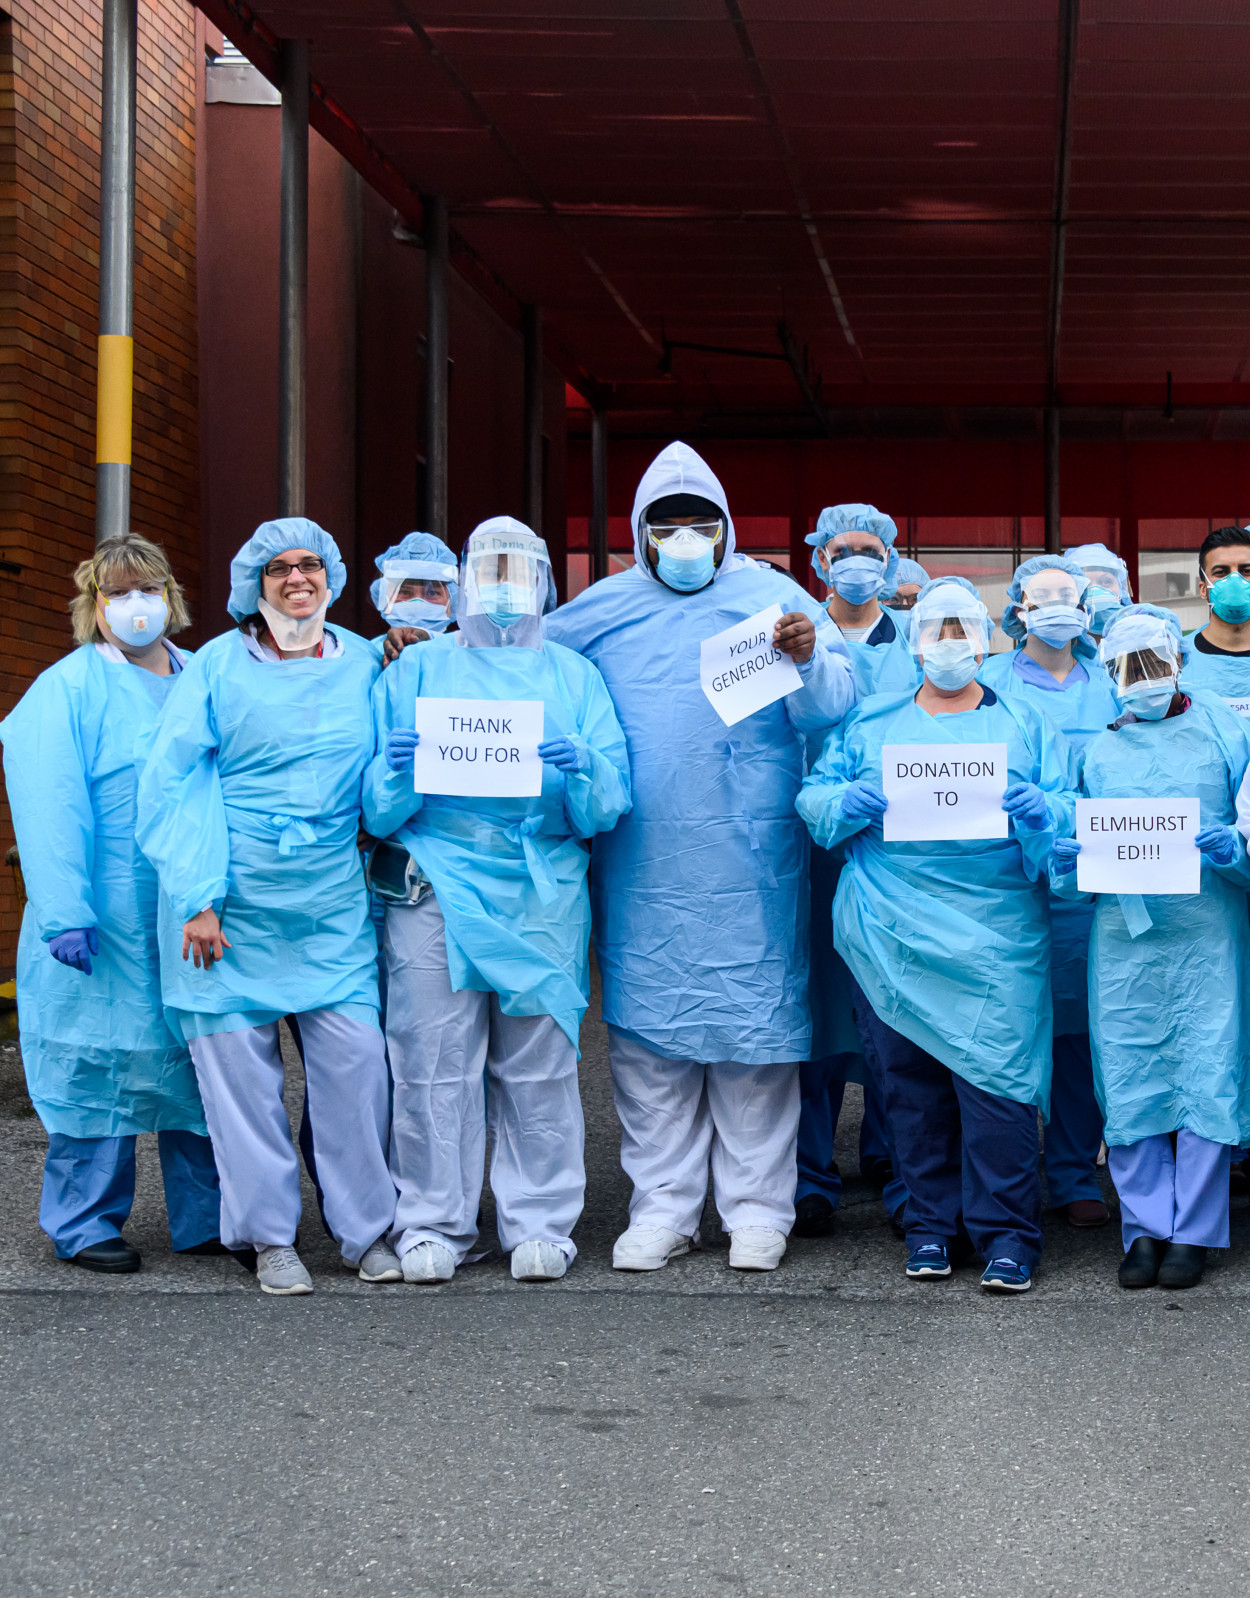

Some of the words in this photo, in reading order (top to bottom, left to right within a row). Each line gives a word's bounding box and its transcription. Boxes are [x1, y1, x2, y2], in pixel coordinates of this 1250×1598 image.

[729, 631, 767, 658] YOUR
[711, 648, 782, 693] GENEROUS
[448, 716, 512, 733] THANK
[438, 745, 478, 762] YOU
[485, 747, 520, 763] FOR
[897, 761, 994, 778] DONATION
[933, 791, 958, 806] TO
[1090, 816, 1188, 832] ELMHURST
[1117, 844, 1161, 860] ED!!!
